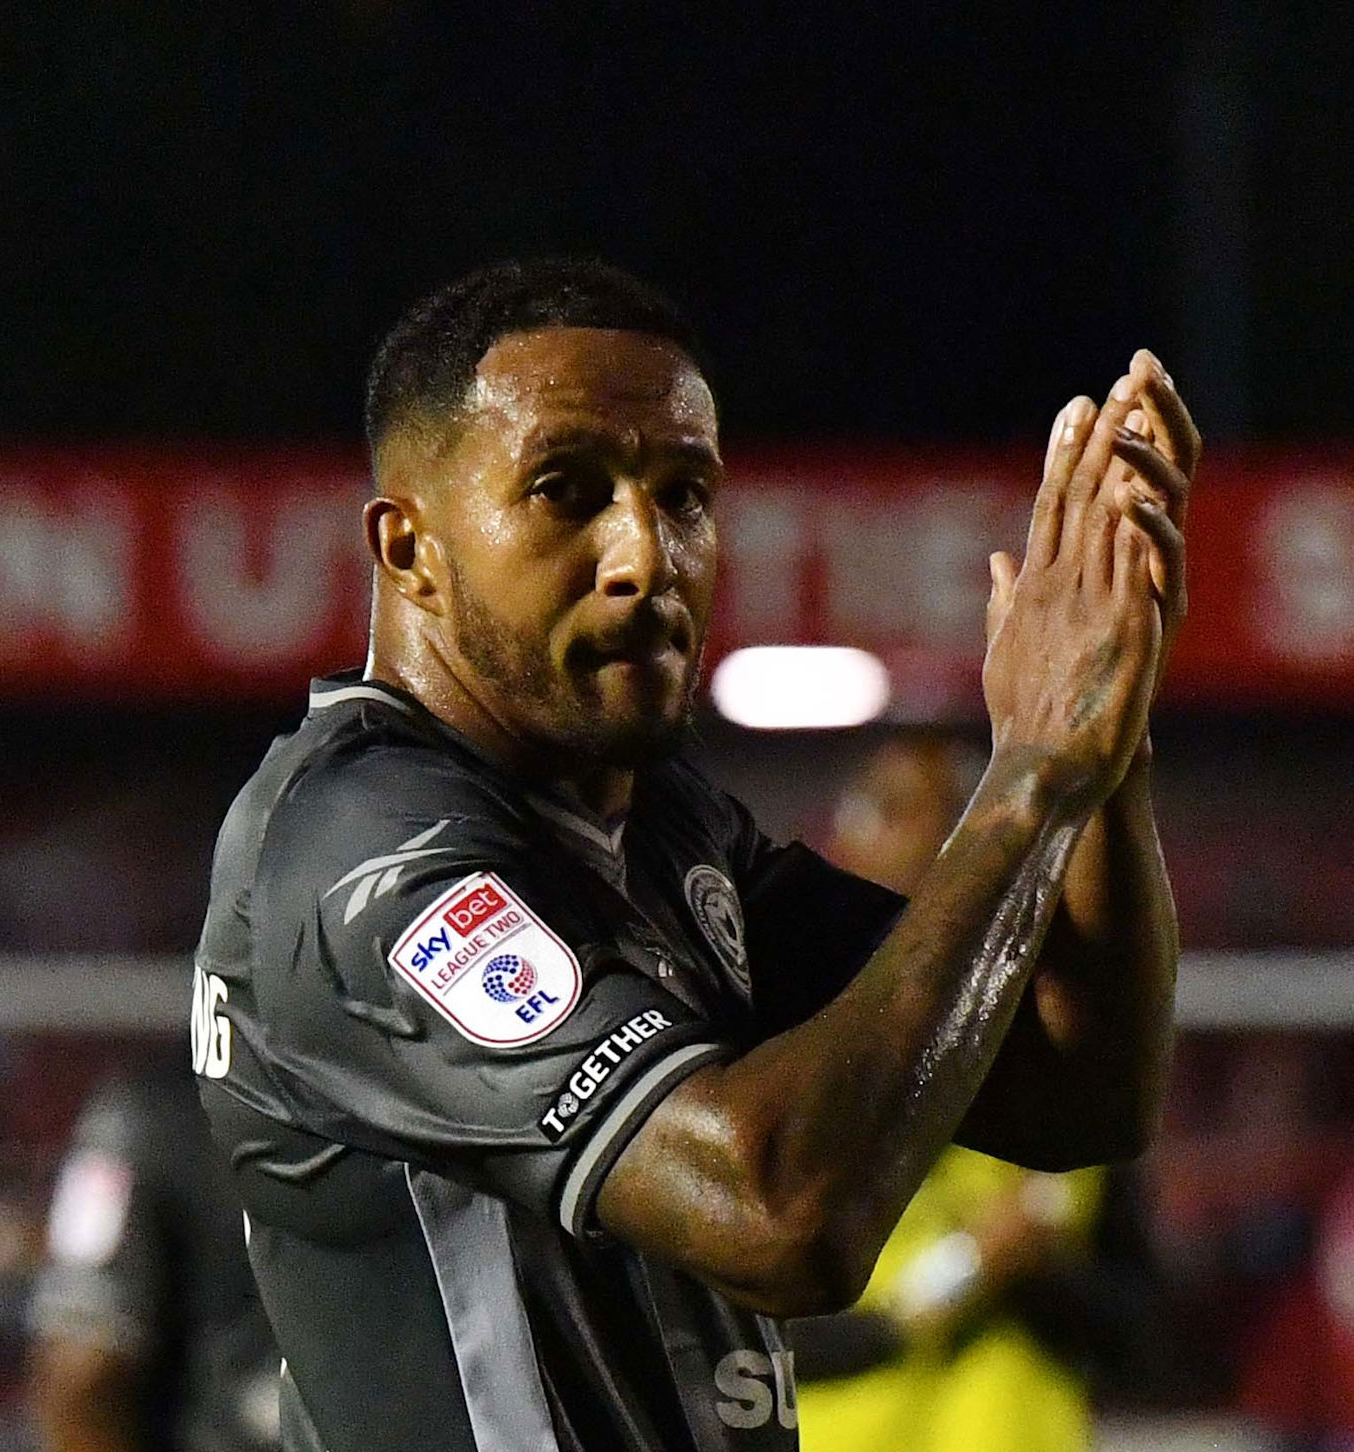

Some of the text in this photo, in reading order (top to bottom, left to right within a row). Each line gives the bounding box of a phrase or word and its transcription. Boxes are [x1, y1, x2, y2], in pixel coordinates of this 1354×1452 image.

[411, 890, 499, 972] sky bet
[431, 910, 522, 989] LEAGUE TWO
[515, 990, 559, 1023] EFL
